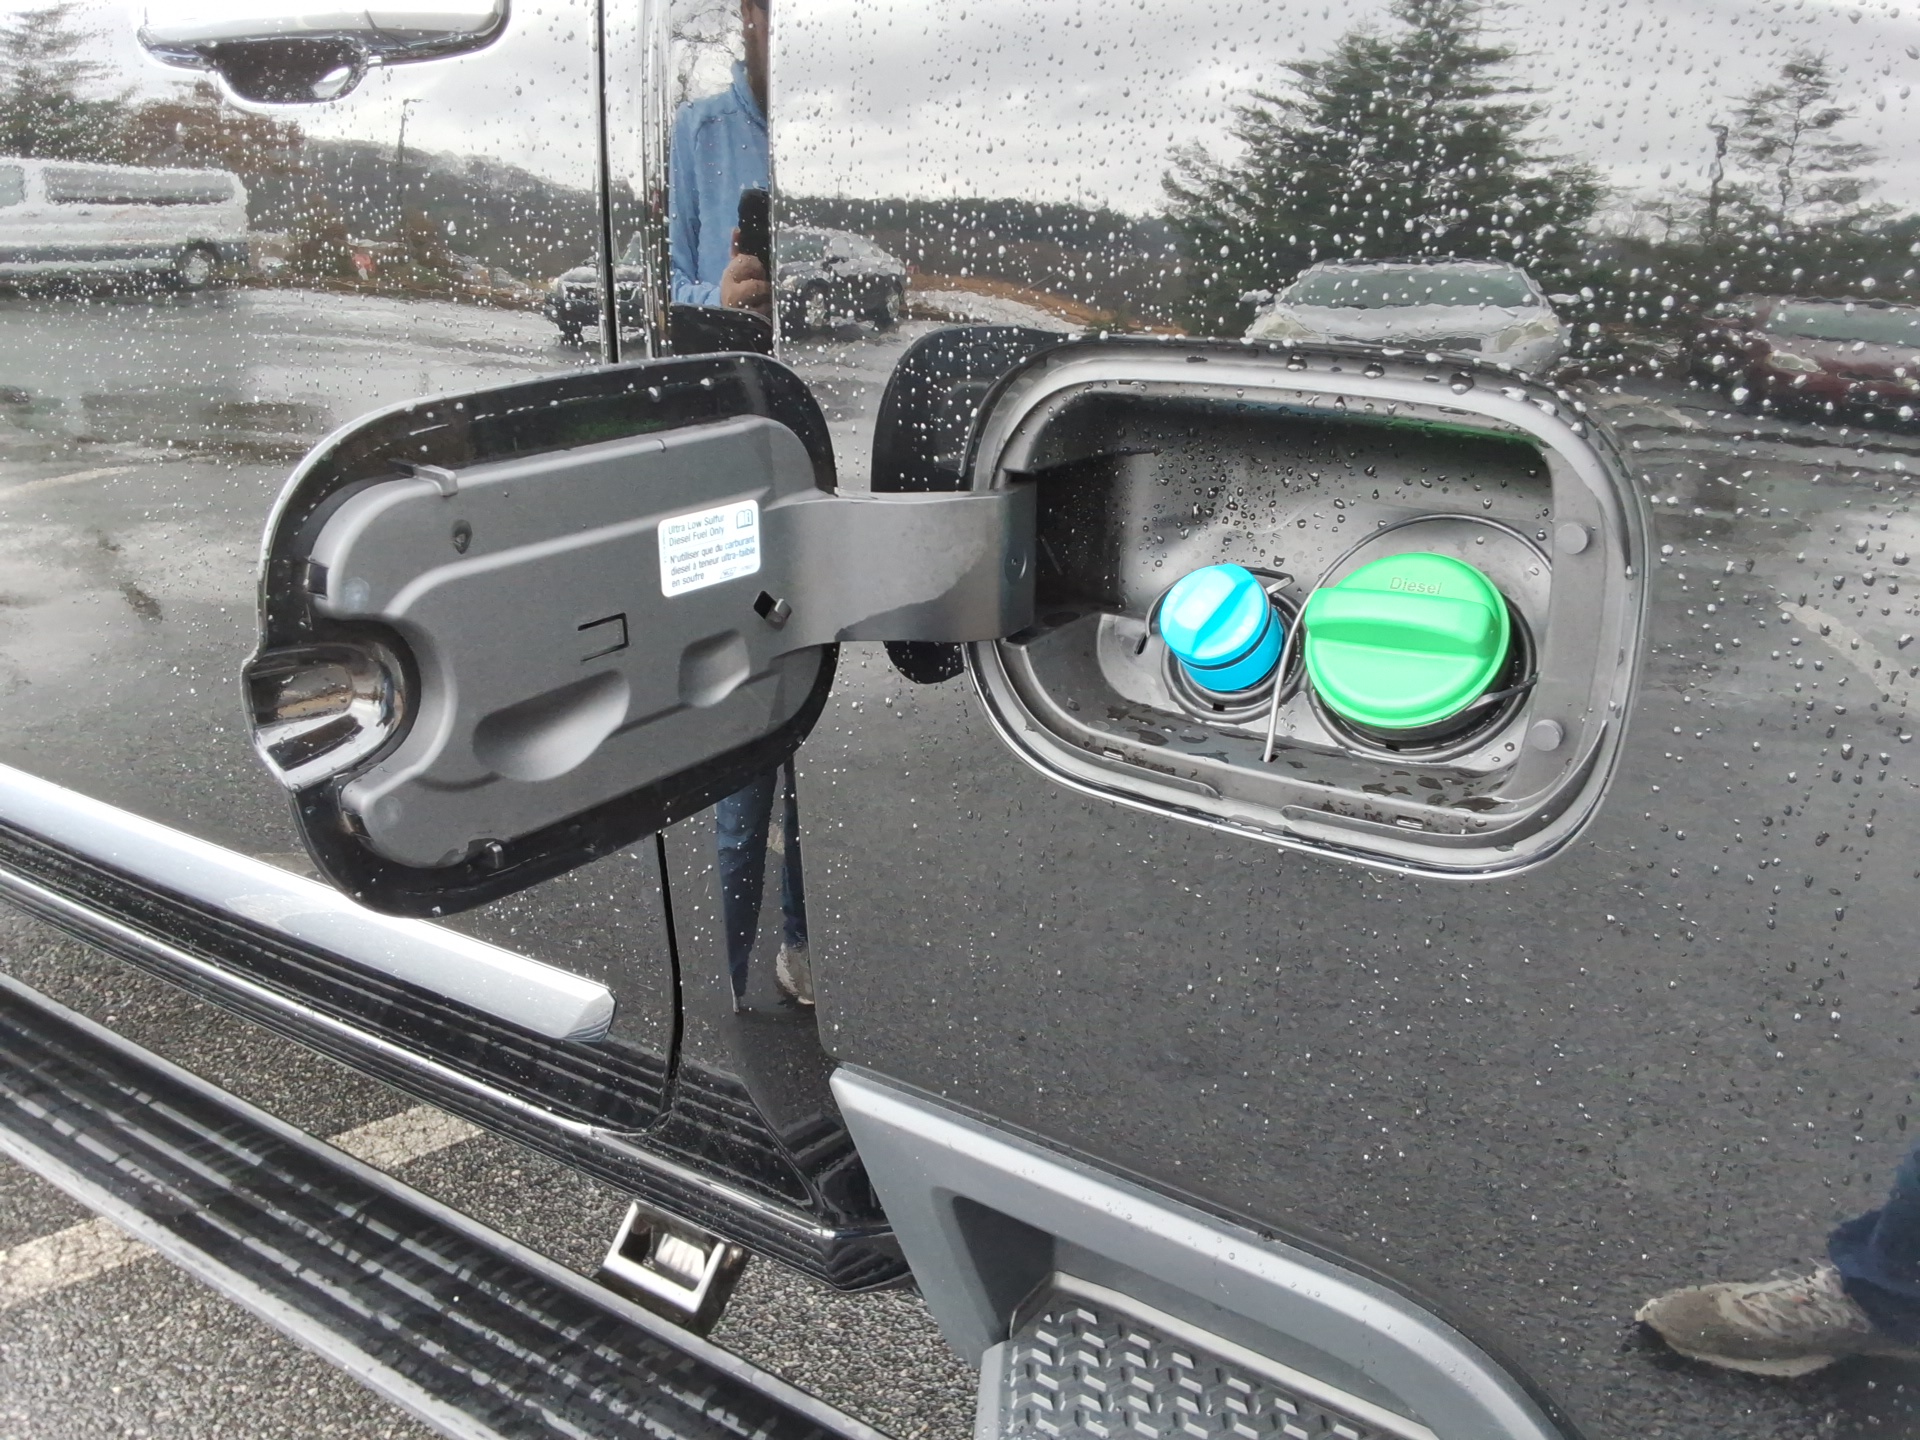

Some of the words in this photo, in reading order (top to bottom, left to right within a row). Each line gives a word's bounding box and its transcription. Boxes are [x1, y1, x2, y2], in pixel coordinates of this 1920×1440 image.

[668, 526, 686, 535] Ultra
[688, 521, 702, 530] Low
[704, 515, 725, 526] Sulfur
[669, 534, 691, 547] Diesel
[693, 530, 708, 540] Fuel
[710, 526, 724, 536] Only
[670, 550, 699, 564] N'utiliser
[701, 547, 713, 557] que
[715, 544, 723, 553] du
[725, 536, 755, 549] carburant
[671, 562, 691, 576] diesel
[698, 557, 719, 568] teneur
[671, 579, 680, 588] en
[682, 572, 704, 585] soufre
[1389, 577, 1442, 595] Diesel
